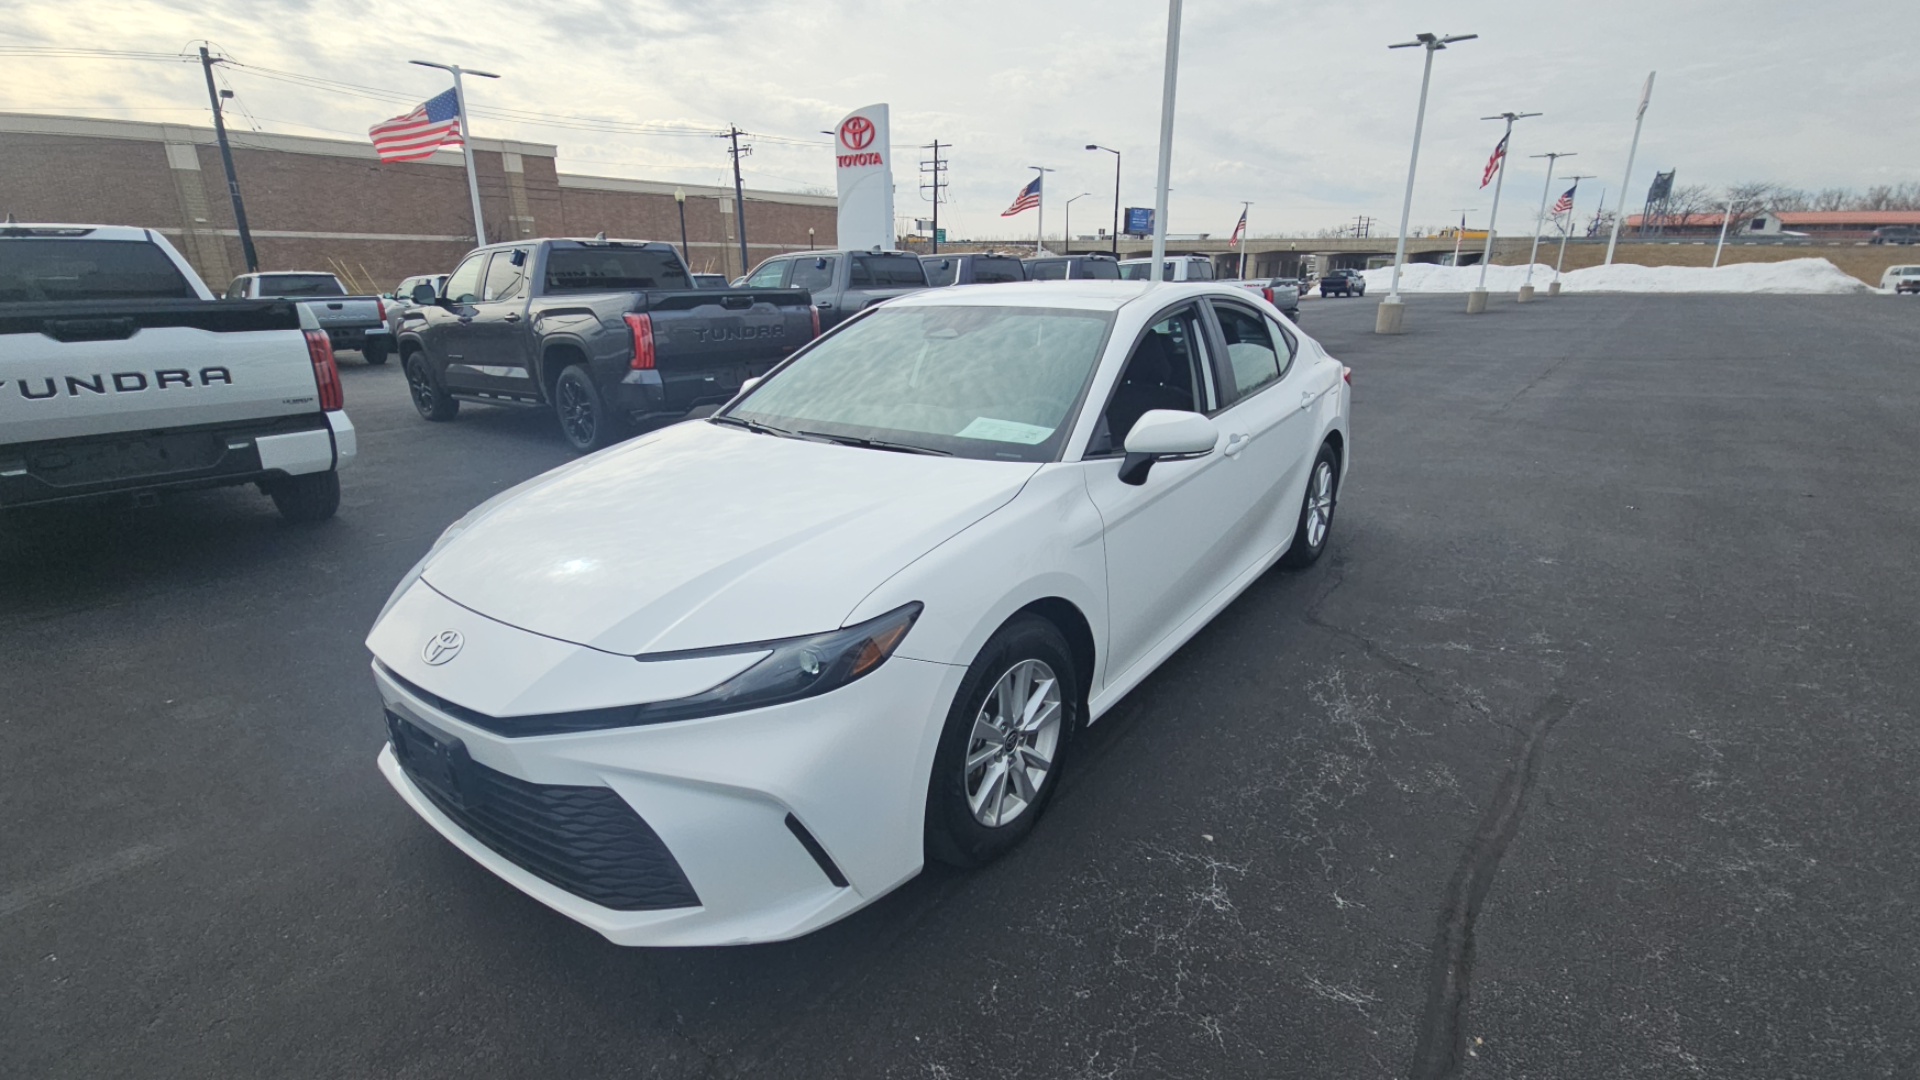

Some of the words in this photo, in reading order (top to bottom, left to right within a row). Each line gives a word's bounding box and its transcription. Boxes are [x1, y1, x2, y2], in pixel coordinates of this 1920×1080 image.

[836, 152, 883, 168] TOYOTA
[693, 324, 785, 343] TUNDRA
[0, 366, 233, 400] UNDRA
